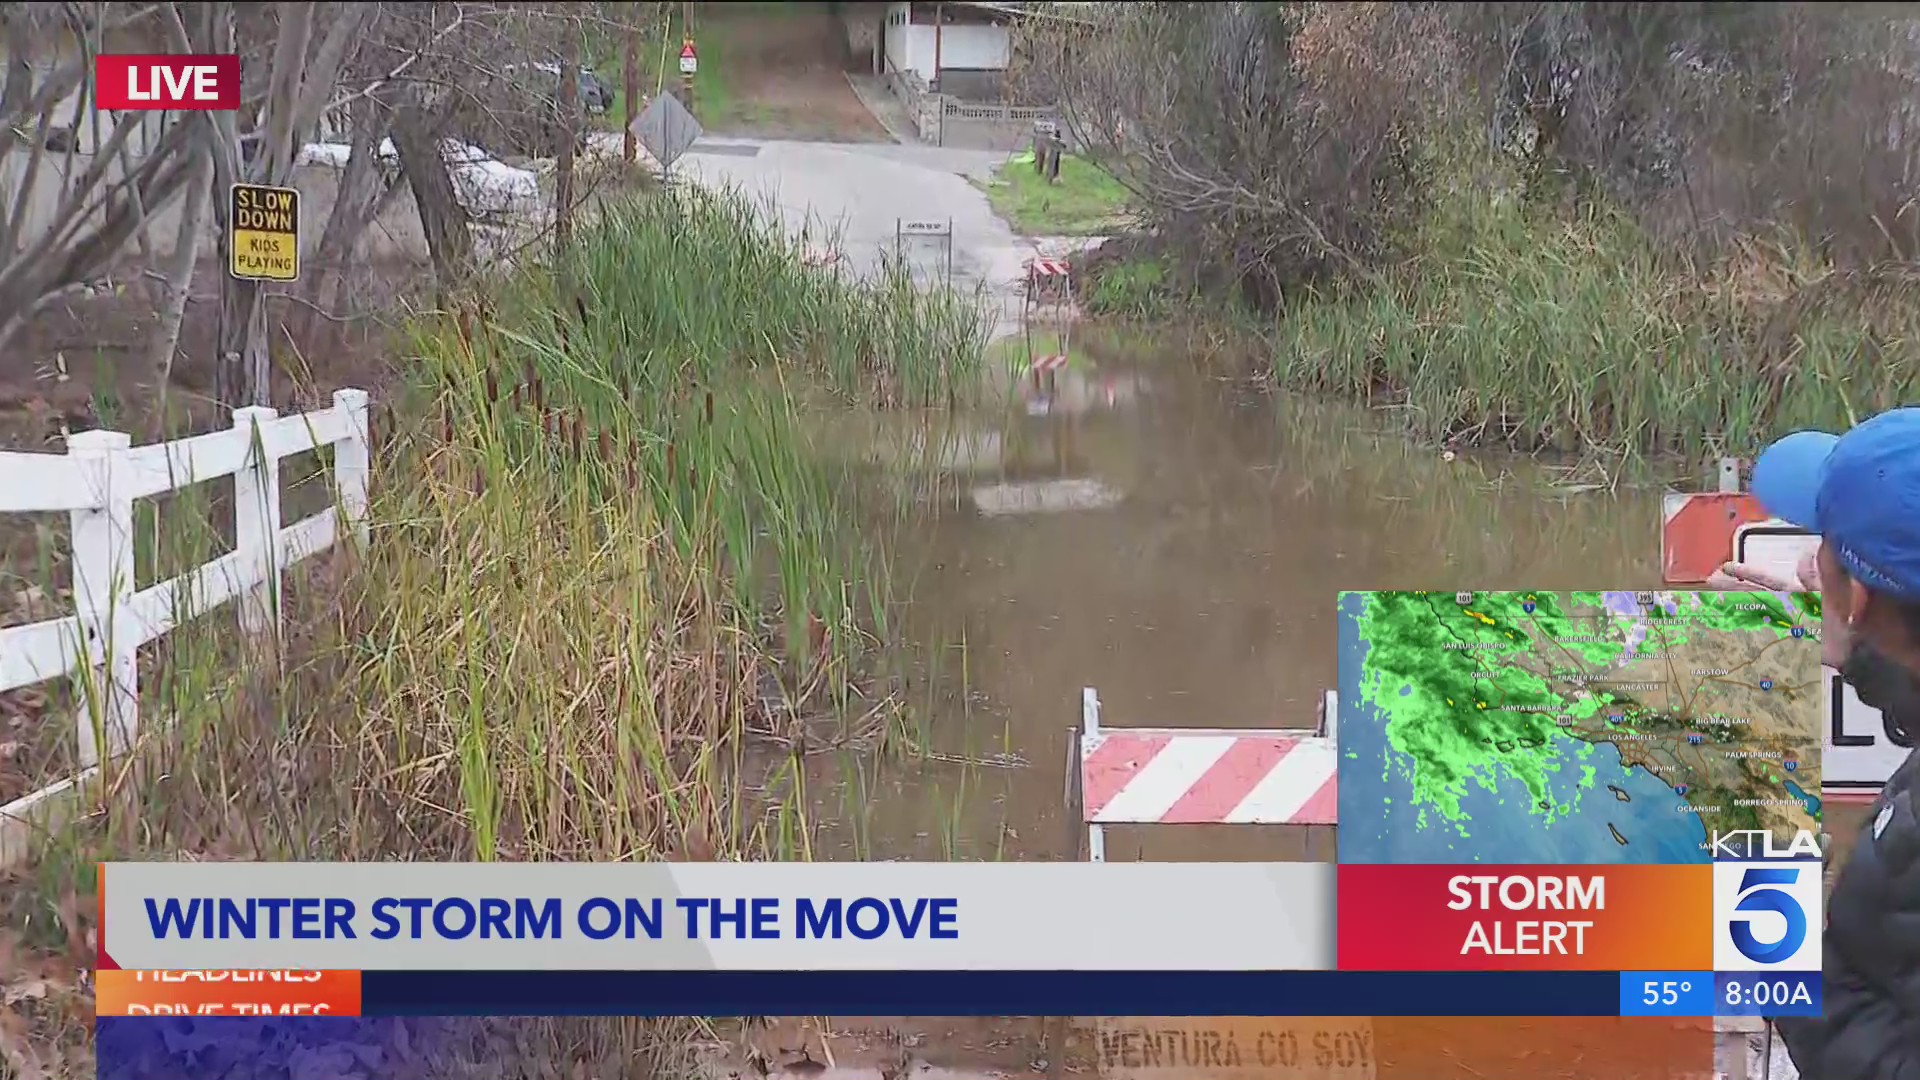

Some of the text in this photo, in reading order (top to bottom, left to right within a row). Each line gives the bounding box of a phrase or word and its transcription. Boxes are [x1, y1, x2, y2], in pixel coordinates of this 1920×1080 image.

[238, 189, 292, 211] SLOW
[238, 209, 292, 231] DOWN
[250, 239, 280, 253] KIDS
[238, 255, 292, 270] PLAYING
[1101, 1029, 1241, 1068] VENTURA
